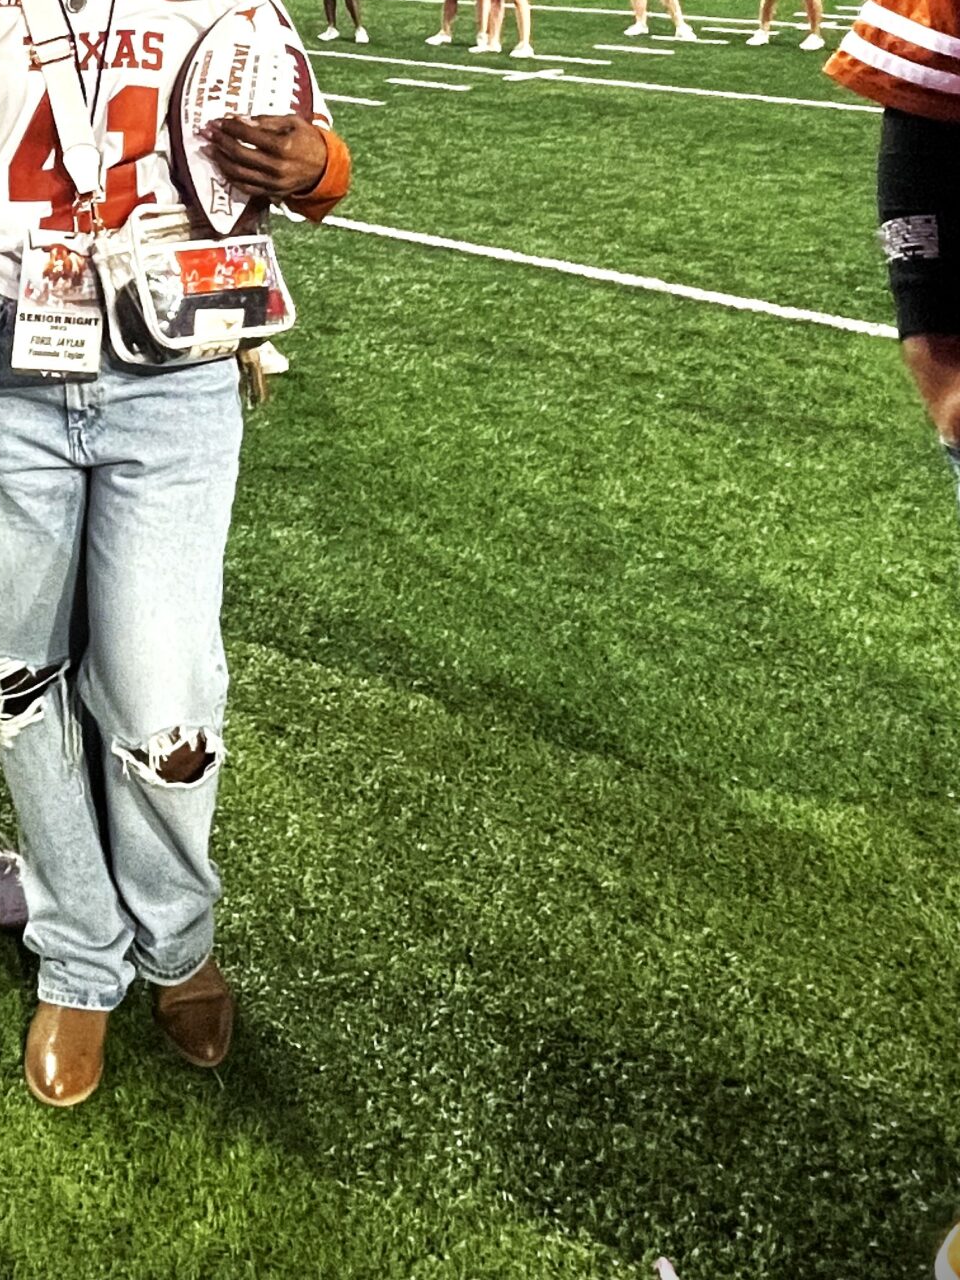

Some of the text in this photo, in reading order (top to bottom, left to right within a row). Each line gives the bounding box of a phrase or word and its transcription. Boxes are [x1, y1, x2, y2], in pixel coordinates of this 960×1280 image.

[8, 84, 160, 234] 41
[19, 312, 62, 324] SENIOR
[63, 316, 100, 327] NIGHT
